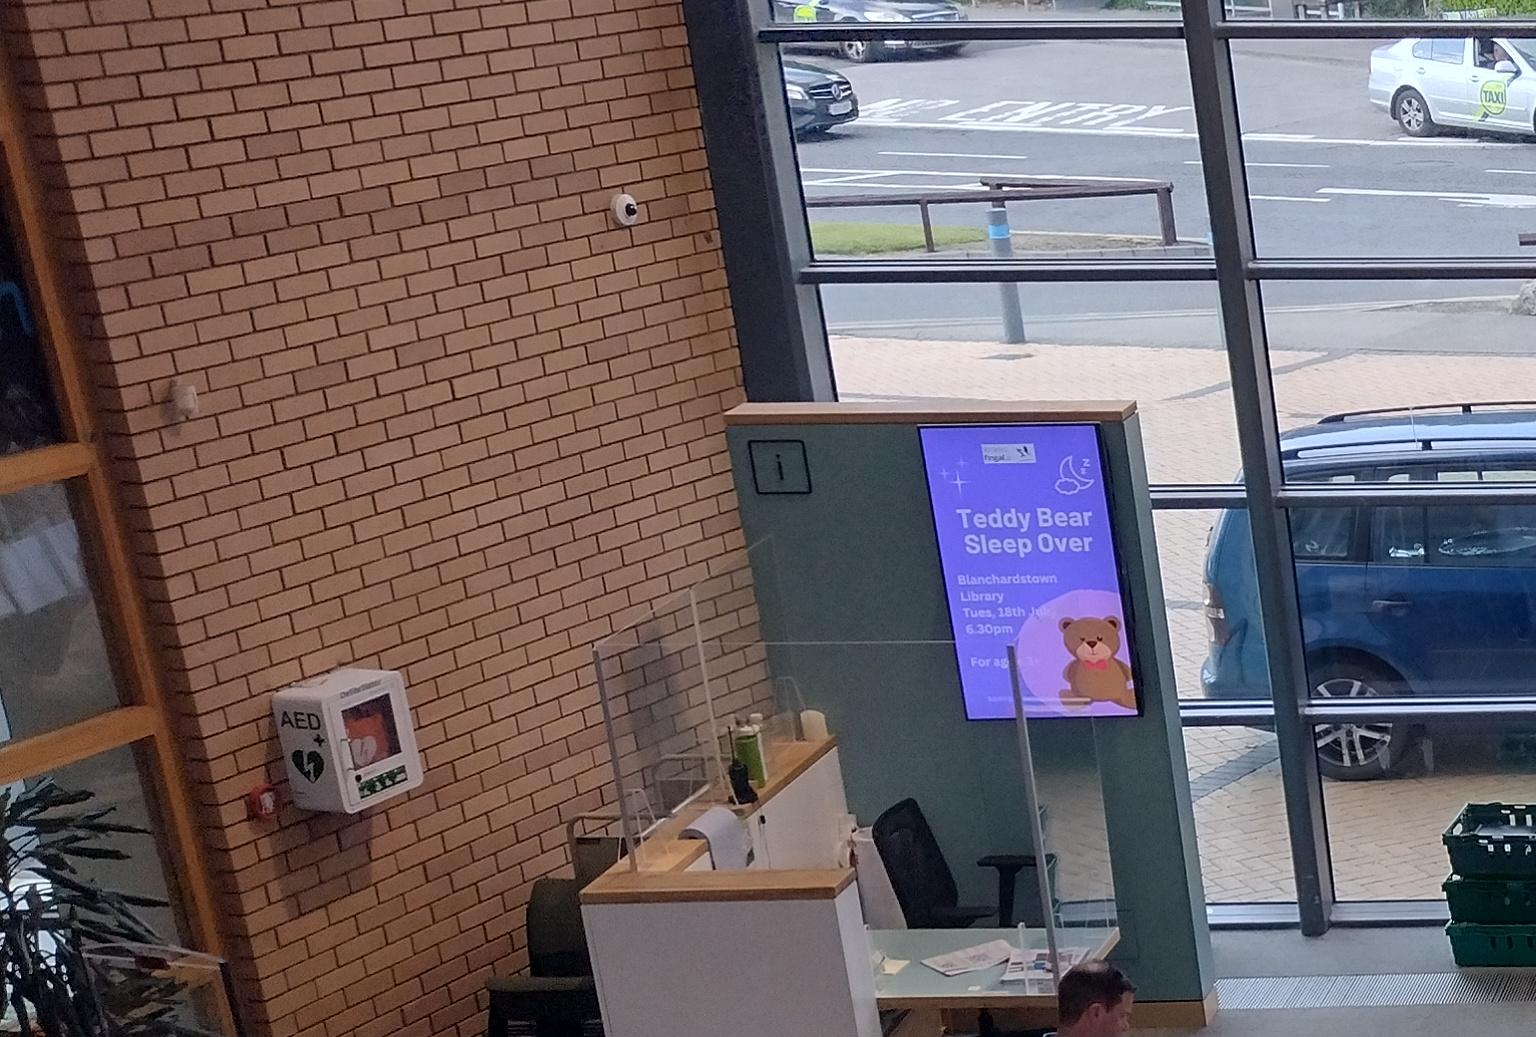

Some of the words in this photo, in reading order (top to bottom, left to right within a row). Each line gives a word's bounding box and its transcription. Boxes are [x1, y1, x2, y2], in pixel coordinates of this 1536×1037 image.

[1483, 90, 1504, 105] TAXI
[956, 508, 1031, 532] Teddy
[1036, 507, 1093, 527] Bear
[964, 534, 1032, 558] Sleep
[1037, 533, 1093, 552] Over
[957, 573, 1058, 585] Blanchardstown
[960, 591, 1004, 604] Library
[998, 606, 1026, 617] 18th
[965, 624, 1013, 636] 6.30pm
[970, 657, 992, 667] For
[281, 711, 321, 730] AED
